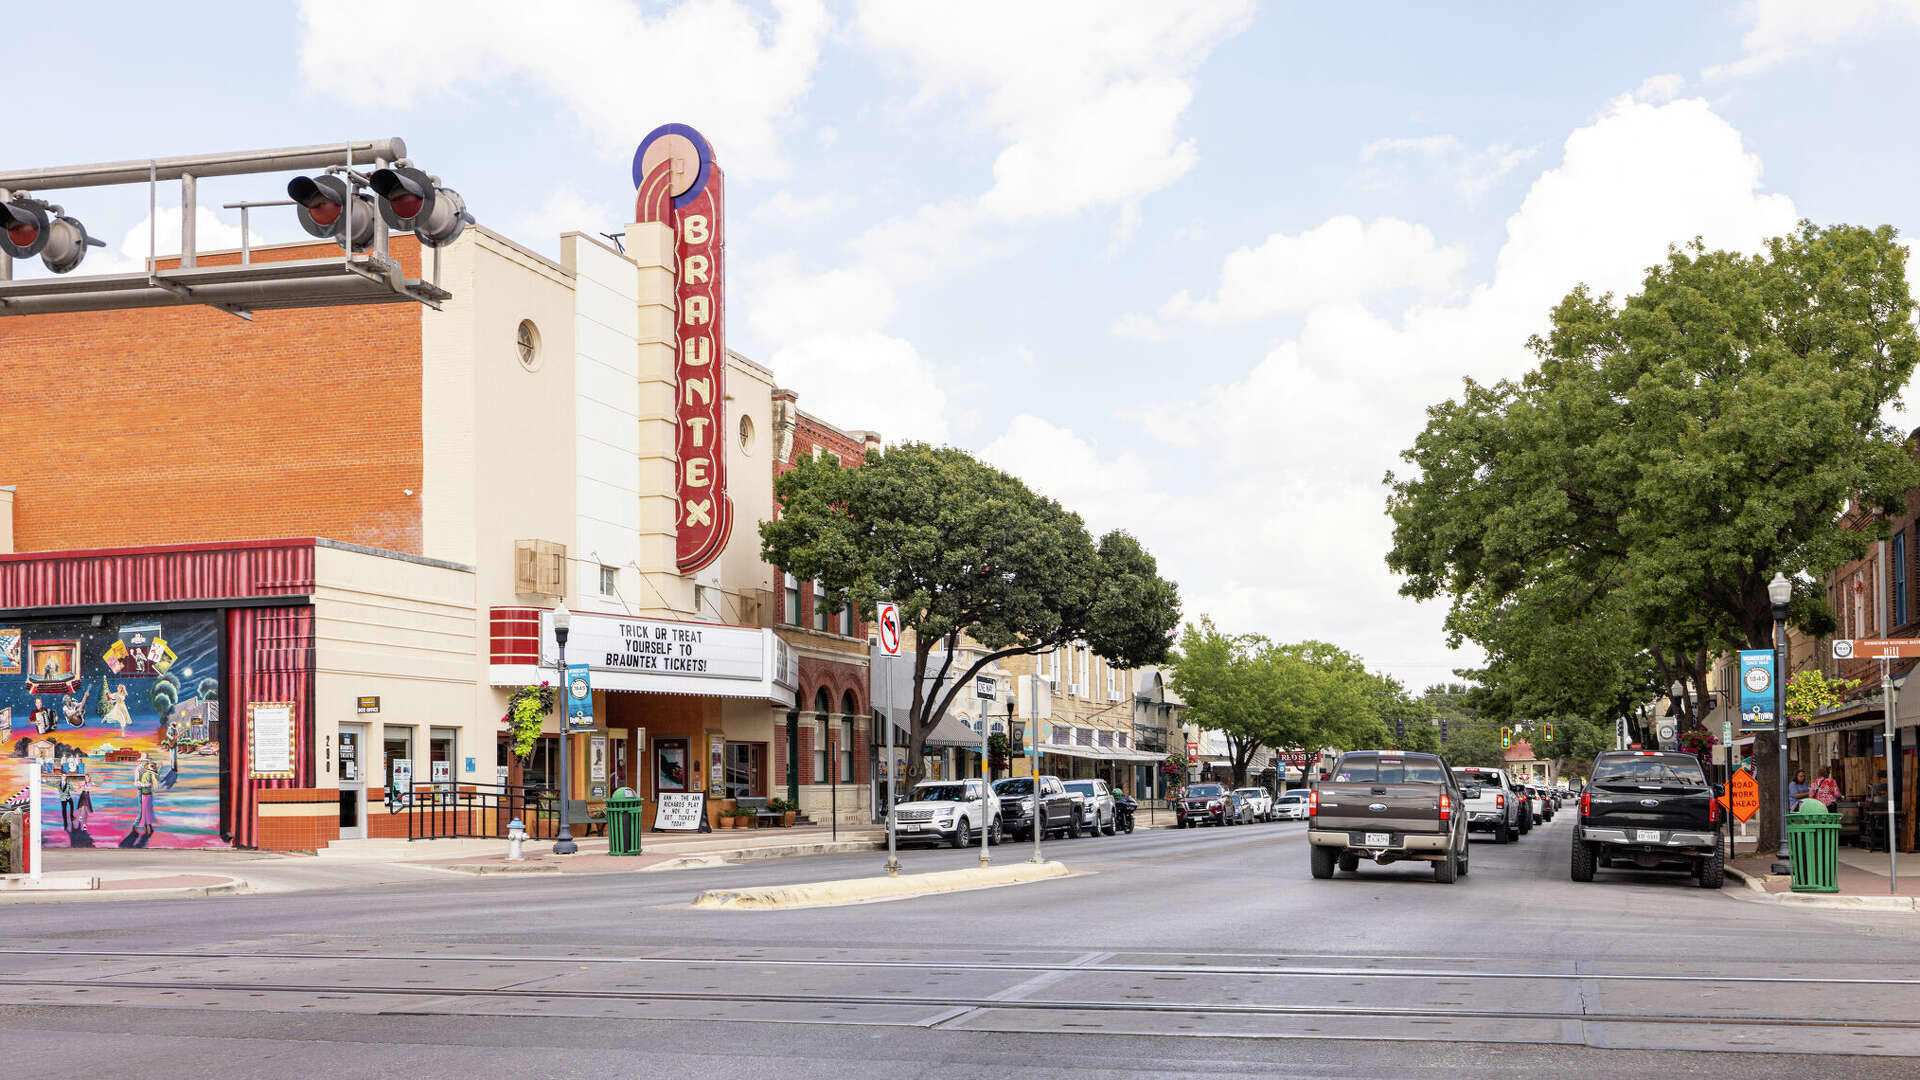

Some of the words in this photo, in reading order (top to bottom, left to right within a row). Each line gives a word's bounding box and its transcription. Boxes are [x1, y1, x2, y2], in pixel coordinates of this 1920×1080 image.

[683, 214, 710, 528] BRAUNTEX
[620, 624, 649, 639] TRICK
[655, 627, 667, 640] OR
[672, 629, 702, 643] TREAT
[626, 640, 672, 655] YOURSELF
[680, 644, 692, 656] TO
[1883, 646, 1899, 656] Hill
[605, 653, 657, 669] BRAUNTEX
[664, 657, 707, 672] TICKETS!
